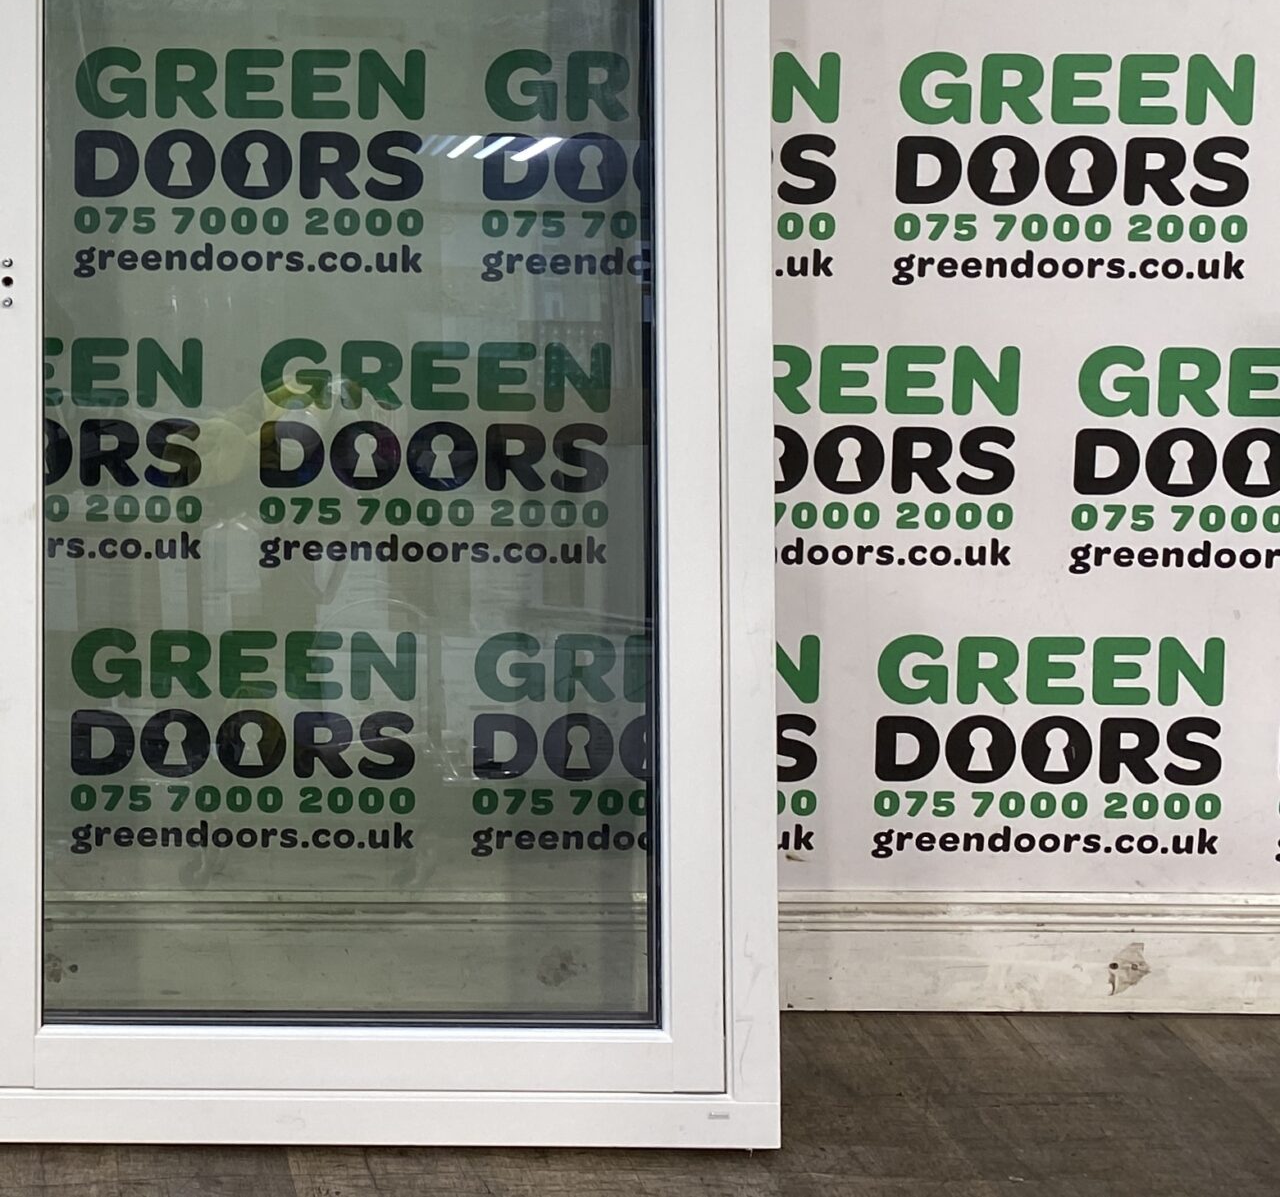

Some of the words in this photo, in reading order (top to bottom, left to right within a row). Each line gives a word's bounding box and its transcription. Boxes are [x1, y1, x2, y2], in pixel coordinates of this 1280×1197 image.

[75, 47, 426, 121] GREEN
[900, 52, 1255, 126] GREEN
[74, 129, 424, 201] DOORS
[896, 135, 1249, 207] DOORS
[74, 206, 155, 234] 075
[172, 207, 288, 235] 7000
[305, 208, 424, 237] 2000
[481, 210, 564, 239] 075
[894, 213, 977, 241] 075
[993, 214, 1111, 242] 7000
[1128, 214, 1247, 243] 2000
[74, 243, 422, 278] greendoors.co.uk
[892, 250, 1244, 285] greendoors.co.uk
[261, 338, 612, 413] GREEN
[259, 420, 609, 493] DOORS
[86, 494, 202, 524] 2000
[259, 496, 341, 525] 075
[357, 498, 474, 527] 7000
[491, 496, 609, 528] 2000
[896, 502, 1013, 530] 2000
[1071, 504, 1154, 531] 075
[259, 533, 607, 568] greendoors.co.uk
[71, 627, 417, 701] GREEN
[878, 634, 1225, 706] GREEN
[71, 709, 415, 780] DOORS
[875, 715, 1222, 786] DOORS
[71, 784, 151, 812] 075
[167, 785, 283, 813] 7000
[299, 786, 416, 815] 2000
[472, 788, 554, 817] 075
[874, 790, 955, 817] 075
[971, 791, 1088, 819] 7000
[1104, 792, 1221, 820] 2000
[70, 820, 414, 854] greendoors.co.uk
[871, 826, 1218, 858] greendoors.co.uk
